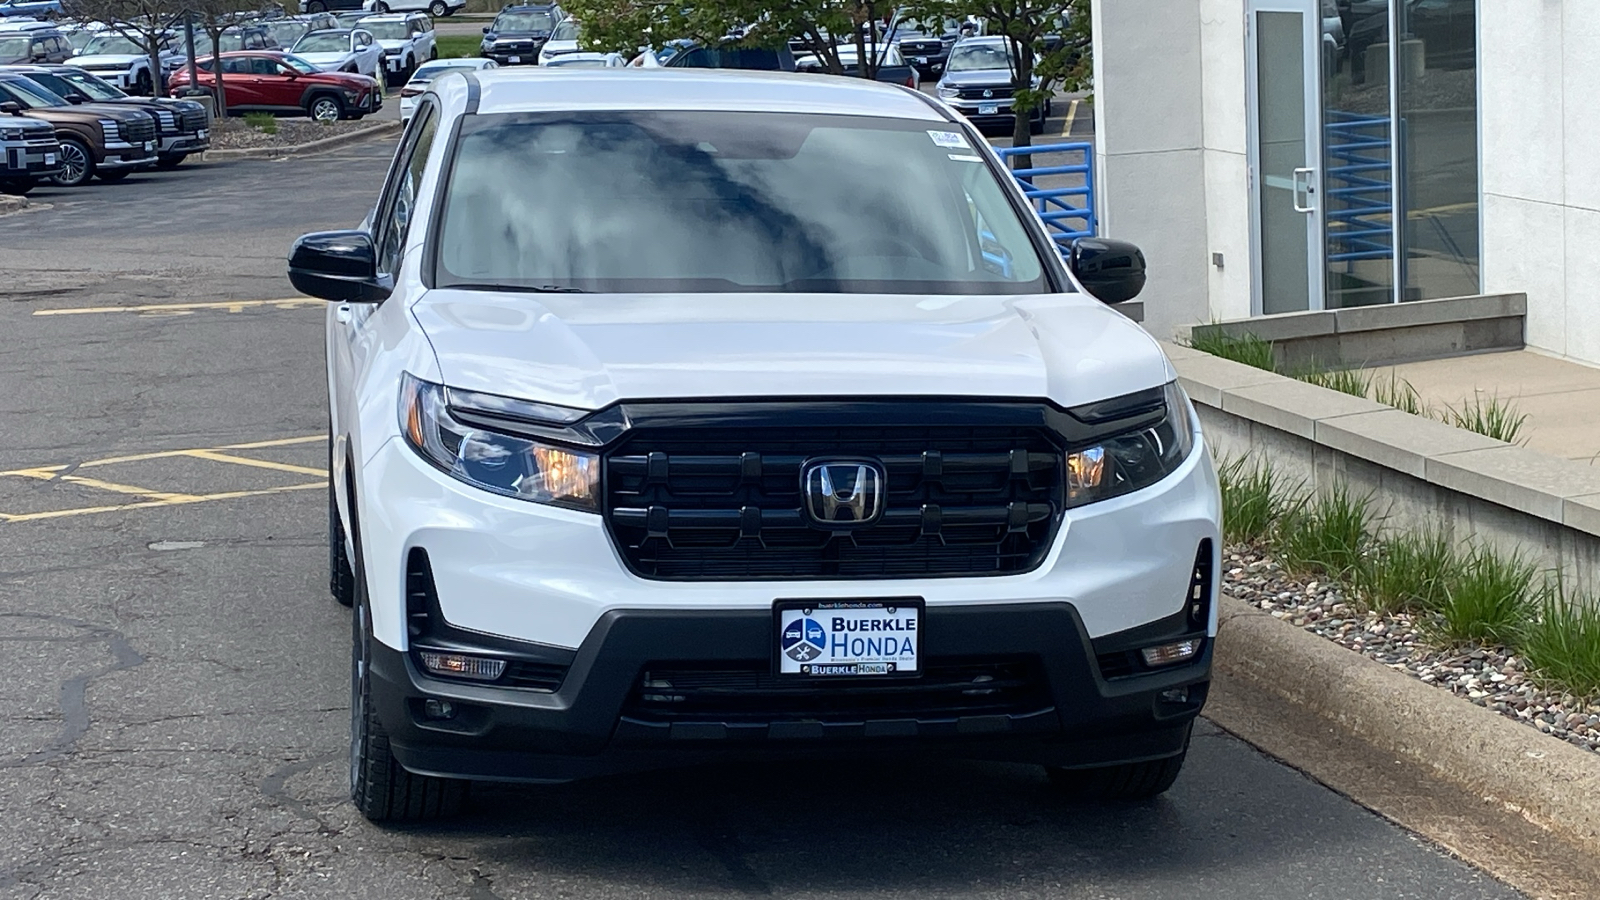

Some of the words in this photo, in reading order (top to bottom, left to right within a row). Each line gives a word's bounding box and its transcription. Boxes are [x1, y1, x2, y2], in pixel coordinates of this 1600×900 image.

[831, 617, 916, 631] BUERKLE
[830, 633, 914, 657] HONDA
[811, 665, 857, 674] BUERKLE
[858, 664, 886, 673] HONDA
